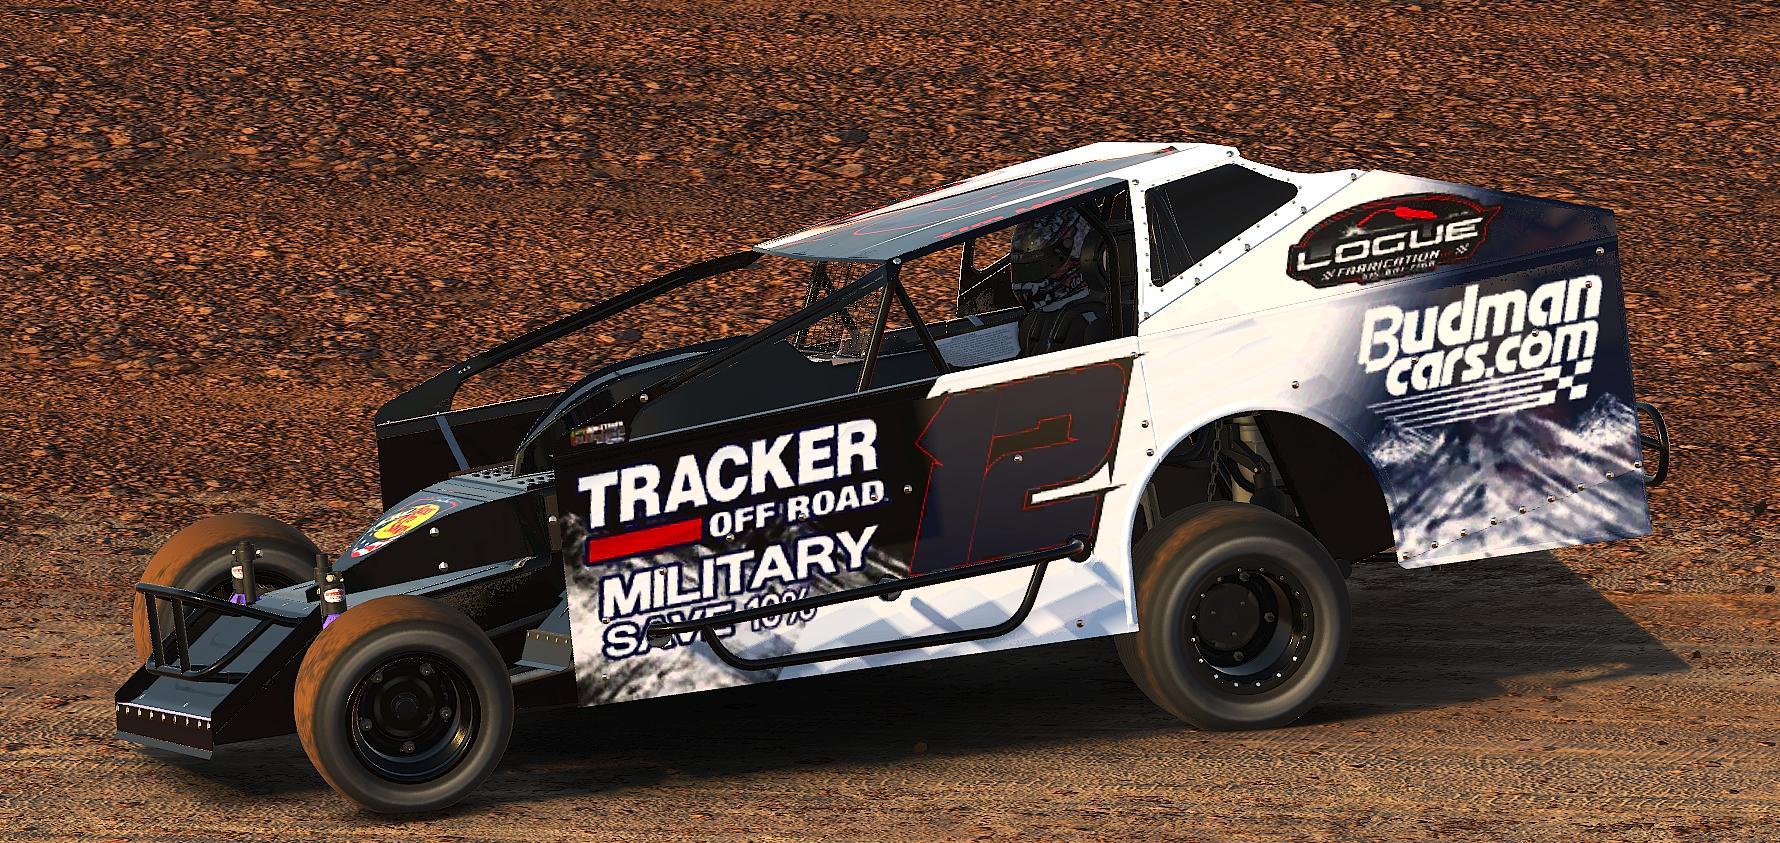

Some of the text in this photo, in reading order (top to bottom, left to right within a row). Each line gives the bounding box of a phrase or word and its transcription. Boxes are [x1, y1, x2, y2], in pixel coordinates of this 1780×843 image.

[1297, 217, 1483, 271] LOGUE
[1358, 275, 1602, 374] Budman
[1386, 320, 1599, 396] cars.com
[577, 418, 878, 529] TRACKER
[709, 480, 885, 538] OFF ROAD
[602, 525, 879, 619] MILITARY
